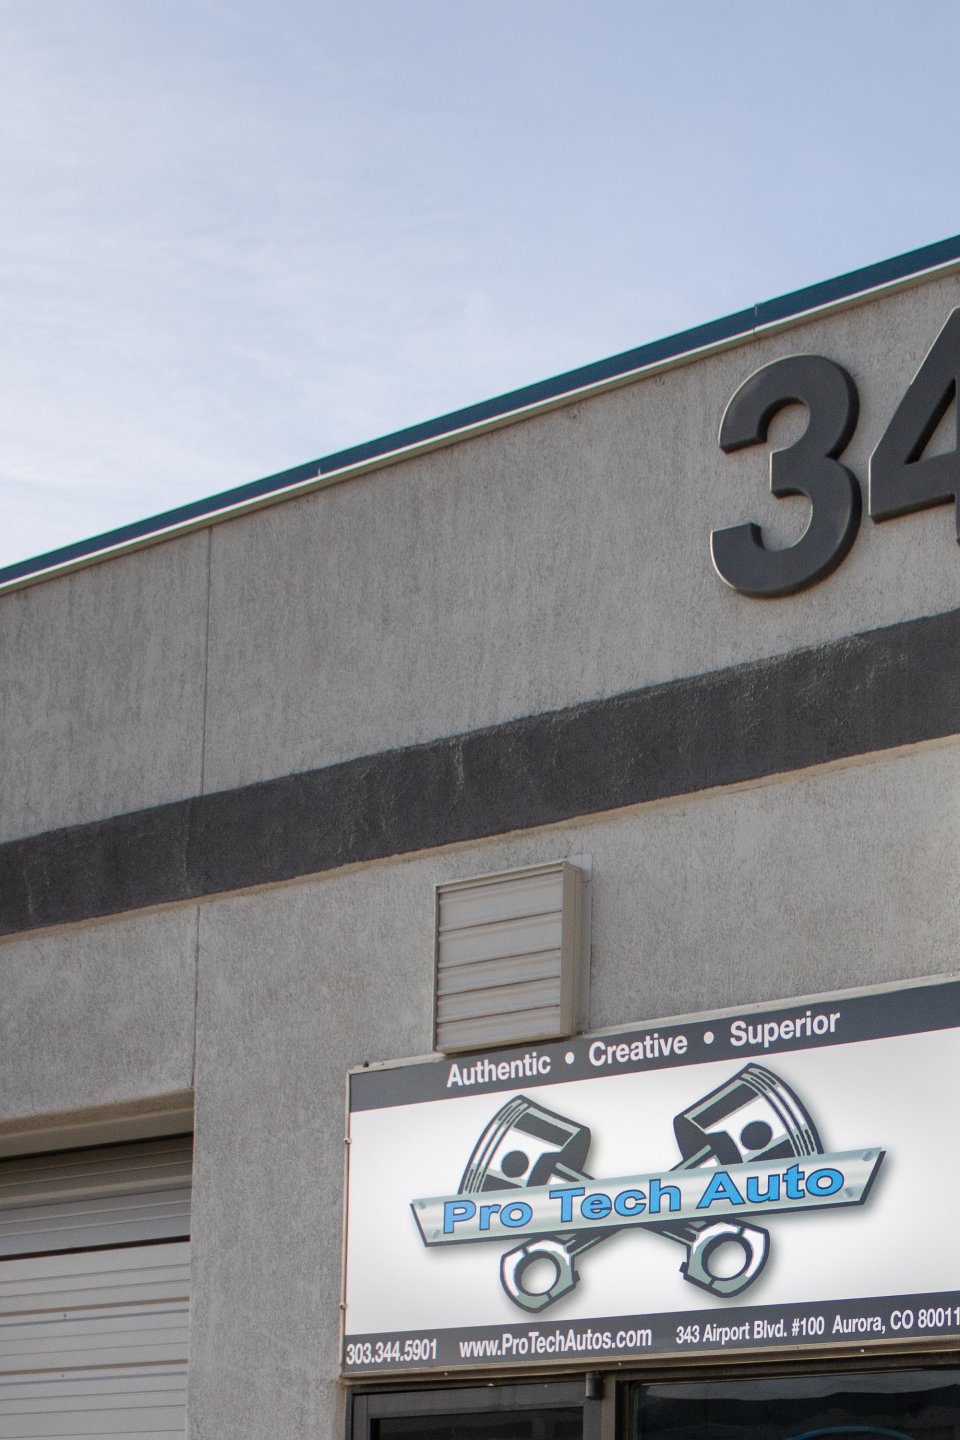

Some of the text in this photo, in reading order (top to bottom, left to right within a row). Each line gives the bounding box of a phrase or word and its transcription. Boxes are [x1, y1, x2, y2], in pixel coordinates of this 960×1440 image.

[446, 1010, 841, 1088] Authentic Creative Superior
[442, 1163, 845, 1234] Pro Tech Auto
[346, 1328, 652, 1365] 303.344.5901 www.ProTechAutos.com
[675, 1306, 960, 1346] 343 Airport Blvd. #100 Aurora, CO 80011
